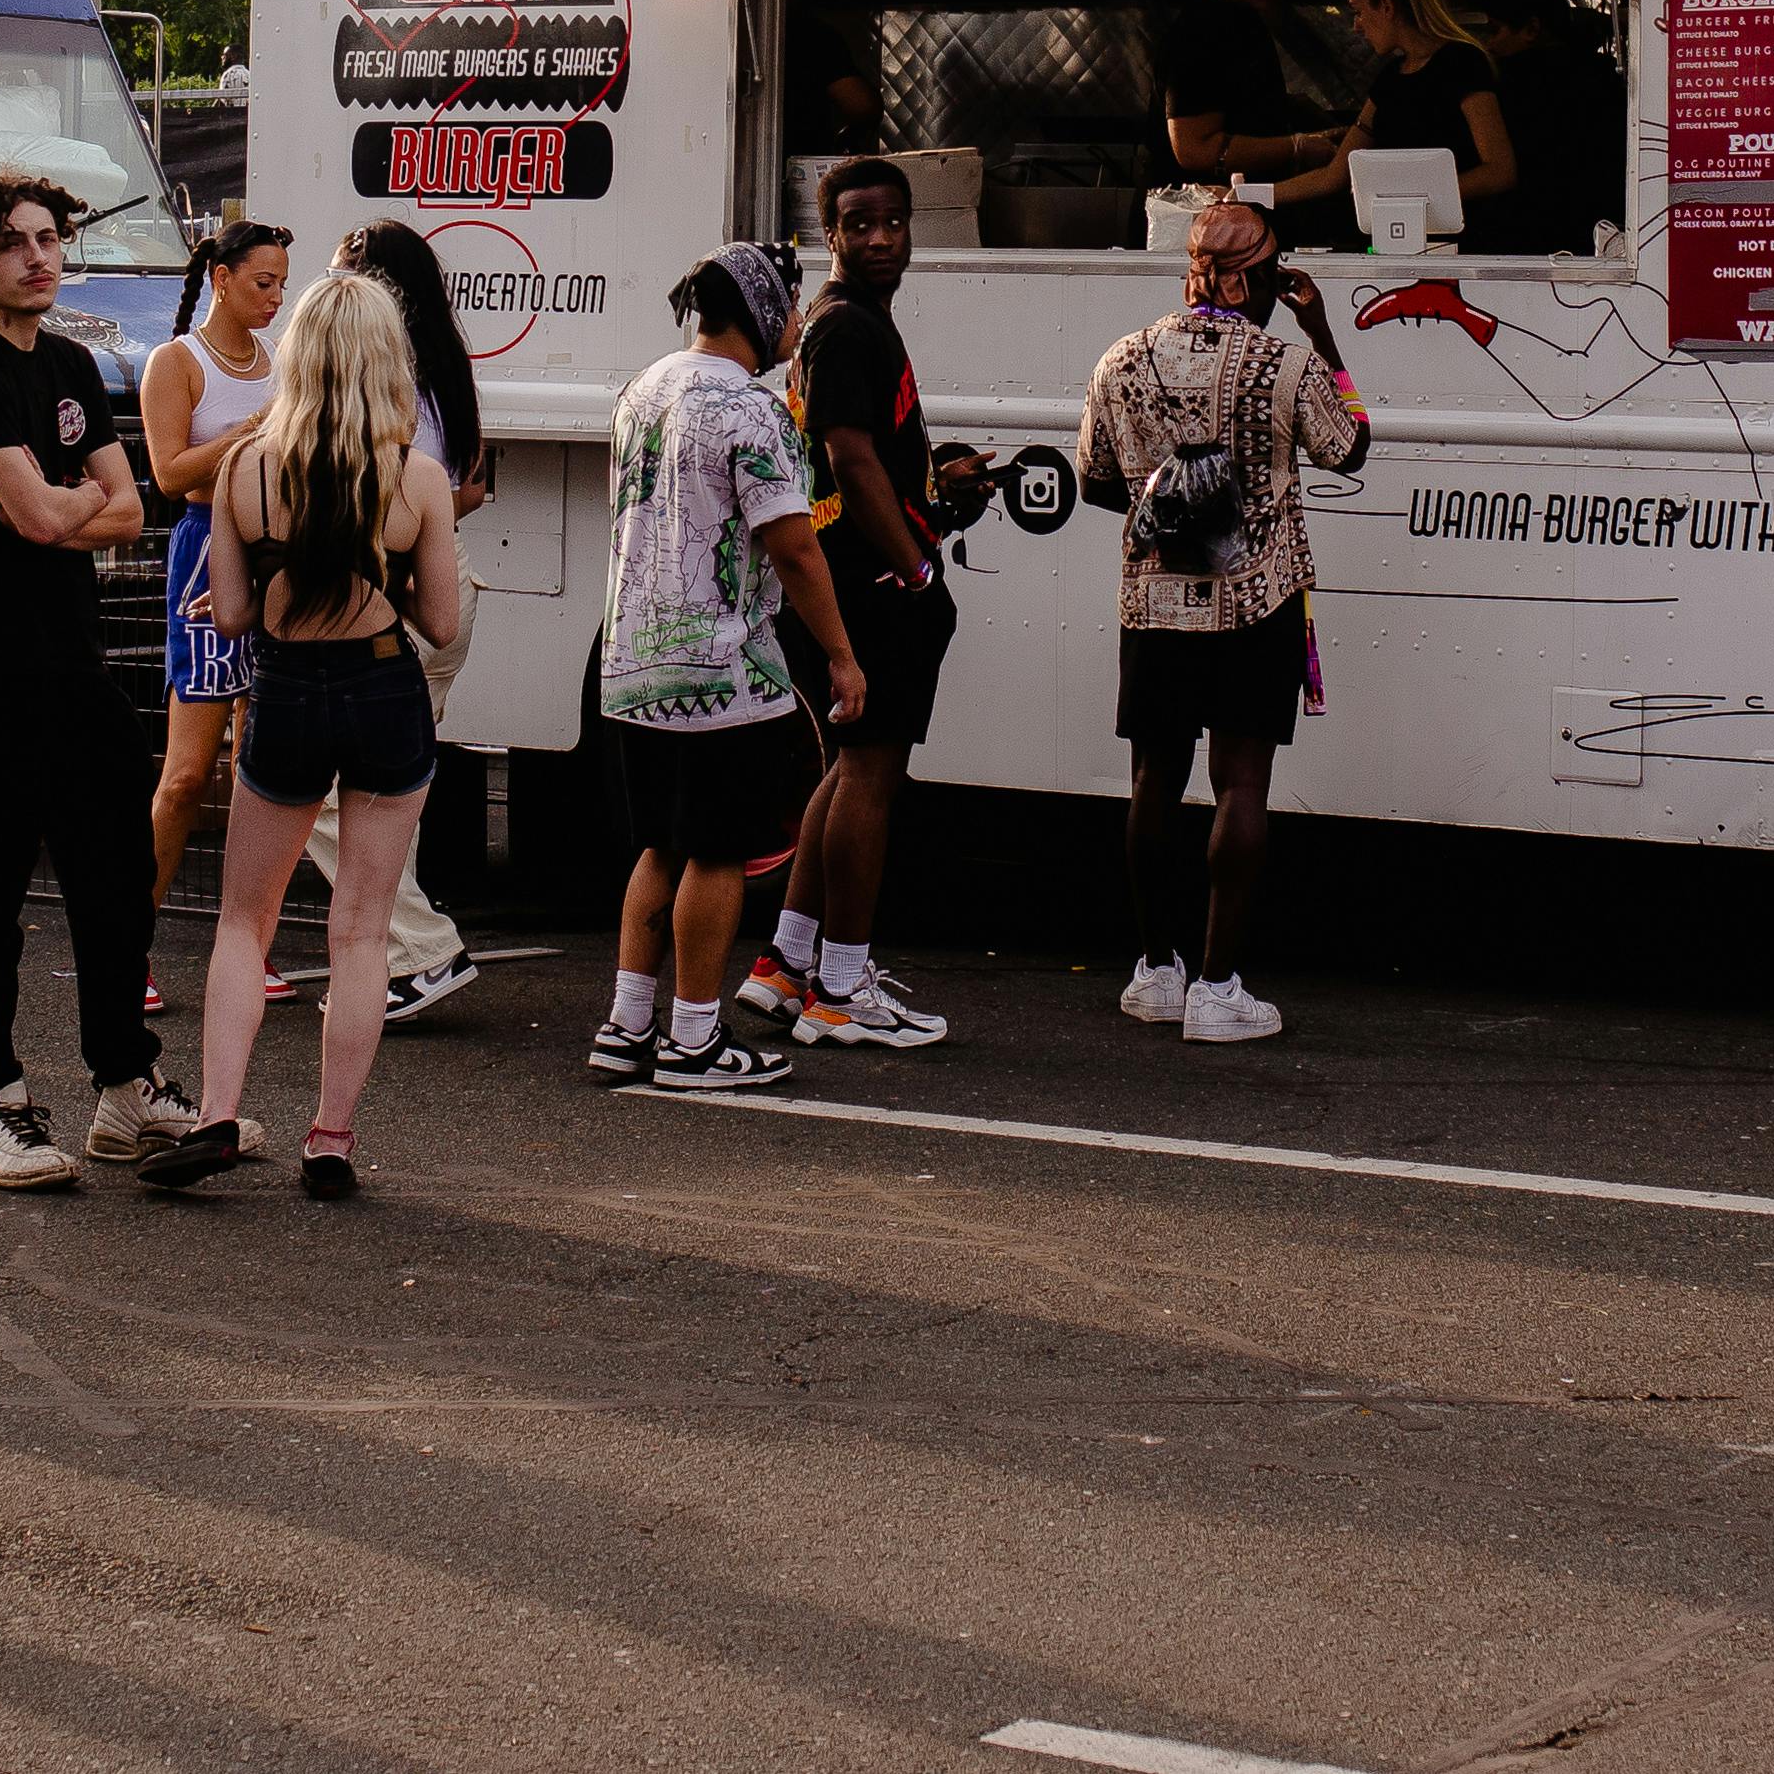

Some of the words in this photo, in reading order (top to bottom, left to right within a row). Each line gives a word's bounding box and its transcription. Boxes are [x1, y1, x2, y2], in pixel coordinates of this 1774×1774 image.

[1676, 17, 1731, 27] BURGER
[1738, 17, 1746, 26] &
[1676, 47, 1727, 58] CHEESE
[342, 50, 396, 78] FRESH
[400, 49, 450, 78] MADE
[454, 48, 528, 78] BURGERS
[534, 48, 545, 77] &
[550, 47, 620, 77] SHAKES
[1676, 77, 1725, 88] BACON
[1676, 108, 1727, 118] VEGGIE
[389, 127, 566, 209] BURGER
[1674, 159, 1699, 169] O.G
[1707, 158, 1771, 168] POUTINE
[1735, 170, 1762, 178] GRAVY
[1674, 208, 1724, 218] BACON
[1738, 240, 1766, 251] HOT
[1713, 267, 1772, 278] CHICKEN
[444, 272, 606, 314] URGERTO.COM
[1409, 487, 1531, 543] WANNA
[1541, 493, 1677, 548] BURGER
